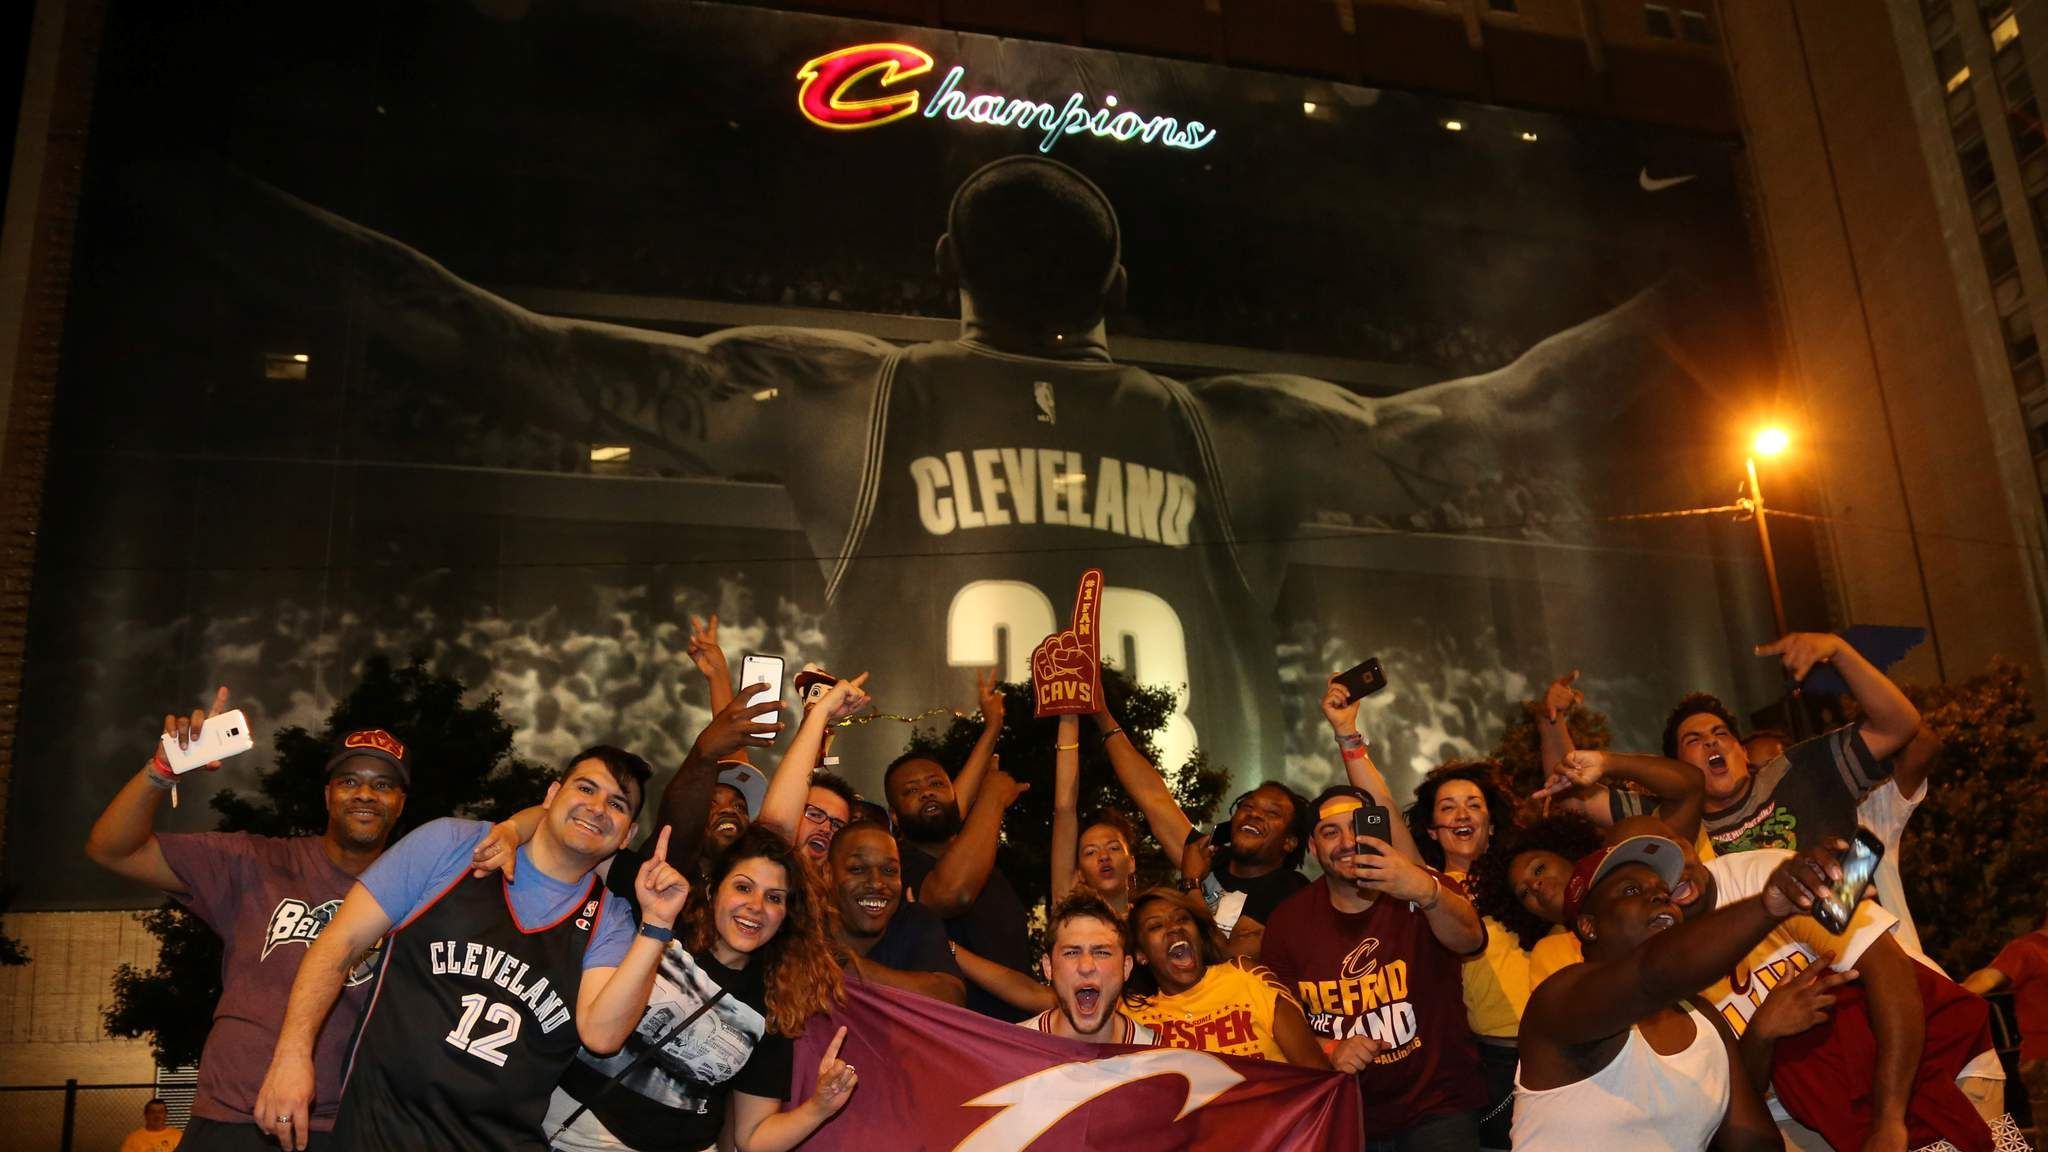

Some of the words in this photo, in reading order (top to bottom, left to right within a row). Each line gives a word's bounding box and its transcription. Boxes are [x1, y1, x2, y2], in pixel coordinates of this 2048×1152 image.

[797, 42, 1216, 153] Champions
[909, 447, 1197, 547] CLEVELAND
[1079, 603, 1092, 635] FAN
[1040, 680, 1092, 705] CAVS
[268, 901, 322, 945] BEL
[430, 940, 571, 1035] CLEVELAND
[445, 993, 522, 1067] 12
